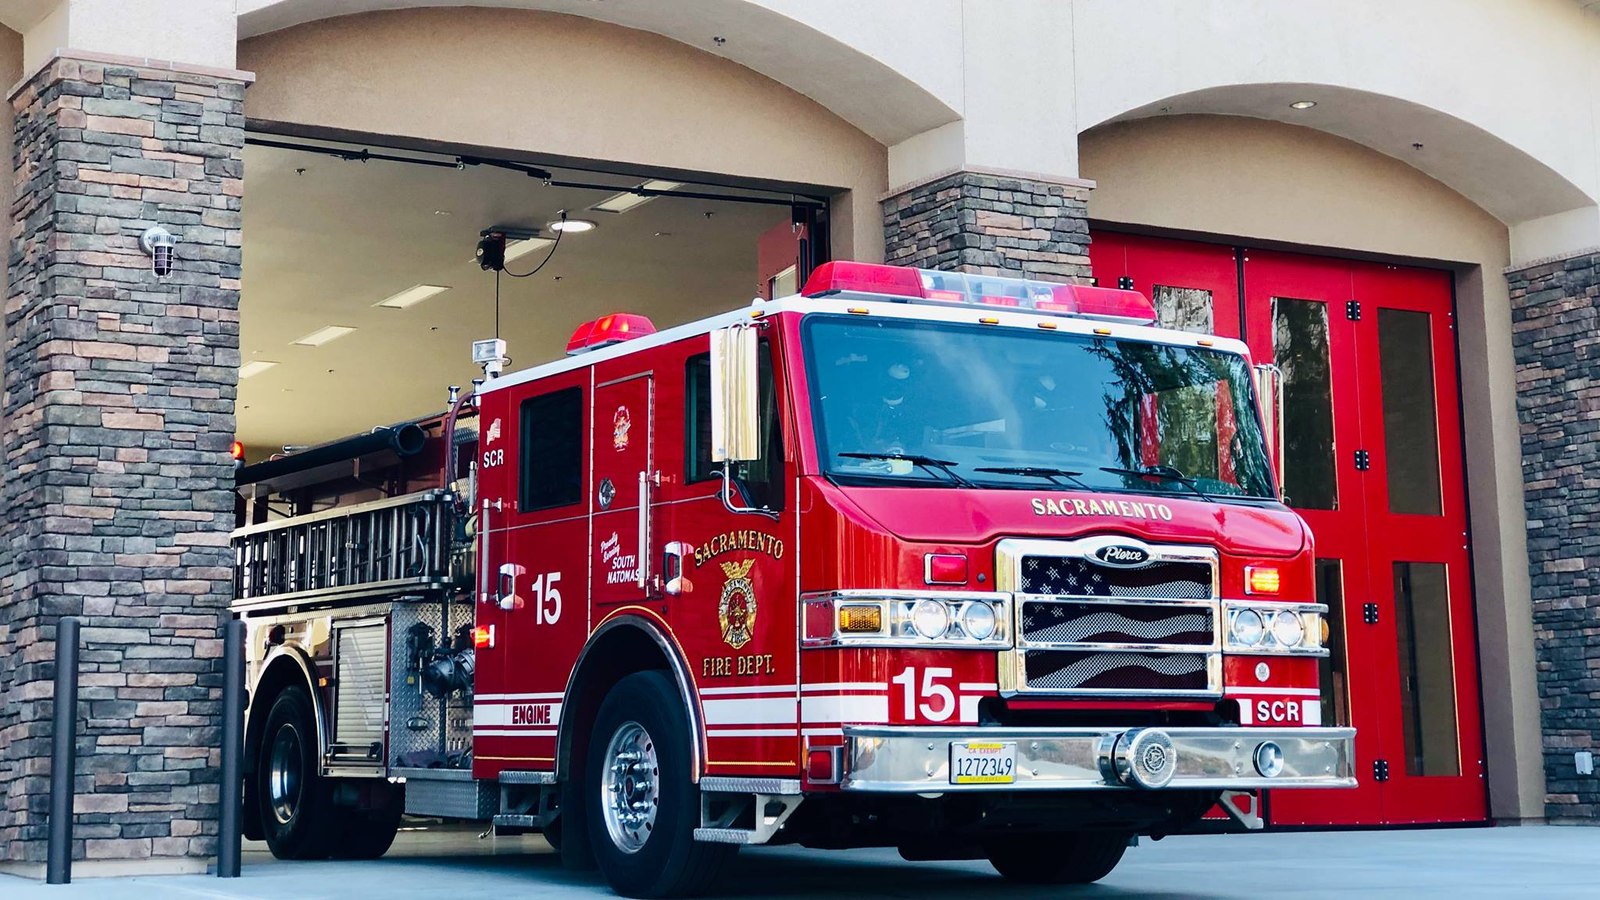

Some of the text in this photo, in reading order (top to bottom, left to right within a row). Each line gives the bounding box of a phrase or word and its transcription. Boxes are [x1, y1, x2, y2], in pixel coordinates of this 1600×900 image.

[483, 449, 504, 468] SCR
[1031, 498, 1173, 521] SACRAMENTO
[694, 530, 784, 567] SACRAMENTO
[1103, 546, 1143, 562] Pierce
[612, 555, 635, 569] SOUTH
[607, 569, 640, 584] NATOMAS
[531, 571, 562, 625] 15
[702, 654, 775, 677] FIRE DEPT.
[892, 666, 956, 722] 15
[512, 705, 551, 724] ENGINE
[1257, 700, 1300, 722] SCR
[957, 757, 1013, 776] 1272349
